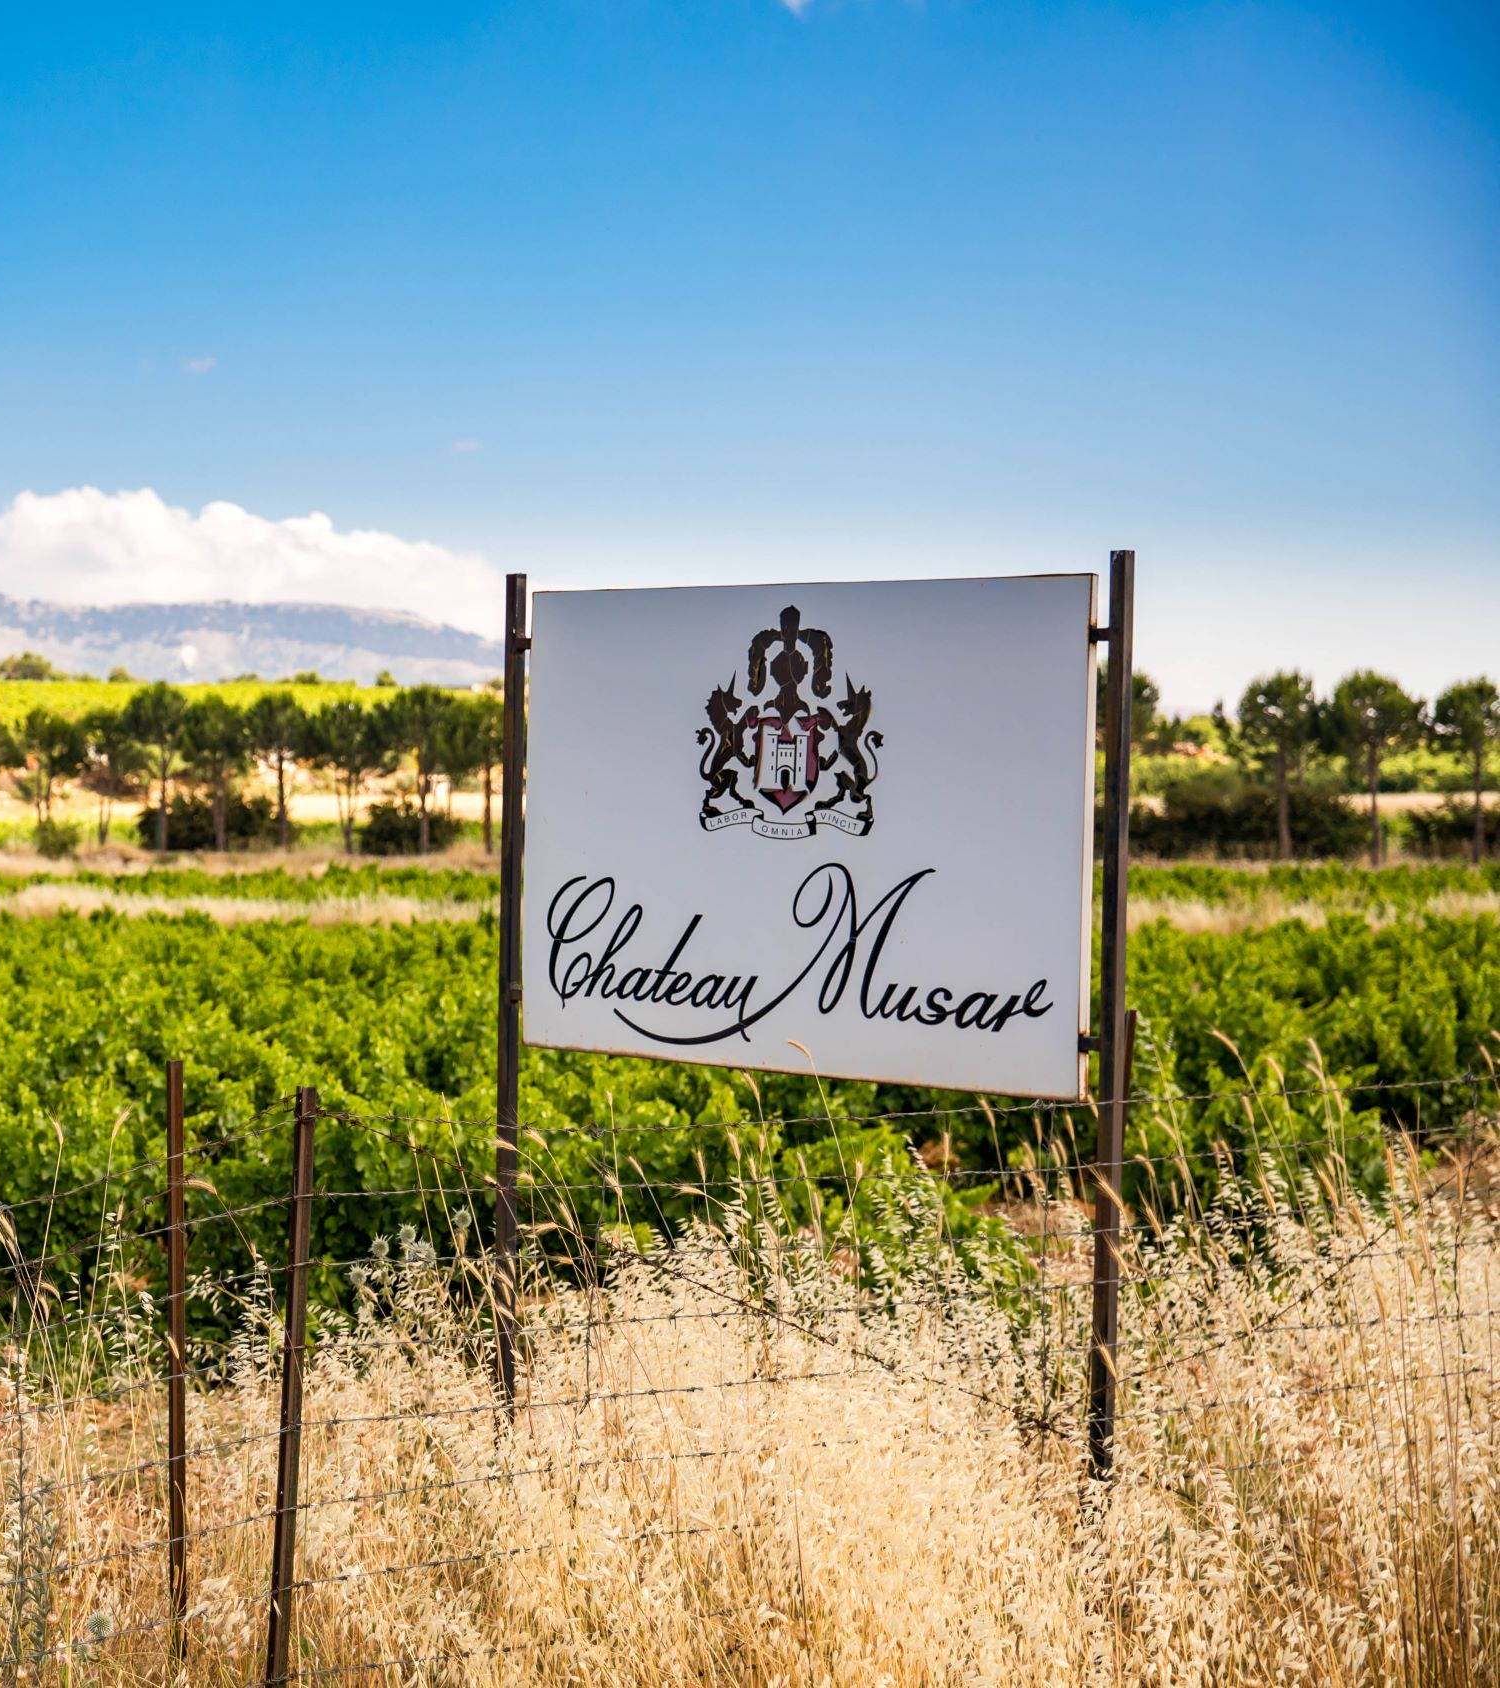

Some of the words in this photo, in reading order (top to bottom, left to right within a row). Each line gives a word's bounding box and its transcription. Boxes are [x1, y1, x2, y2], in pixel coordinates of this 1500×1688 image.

[709, 811, 748, 828] LABOR
[761, 824, 804, 837] OMNIA
[820, 812, 859, 832] VINCIT
[547, 876, 758, 1042] Chateau
[784, 863, 1054, 1032] Musar
